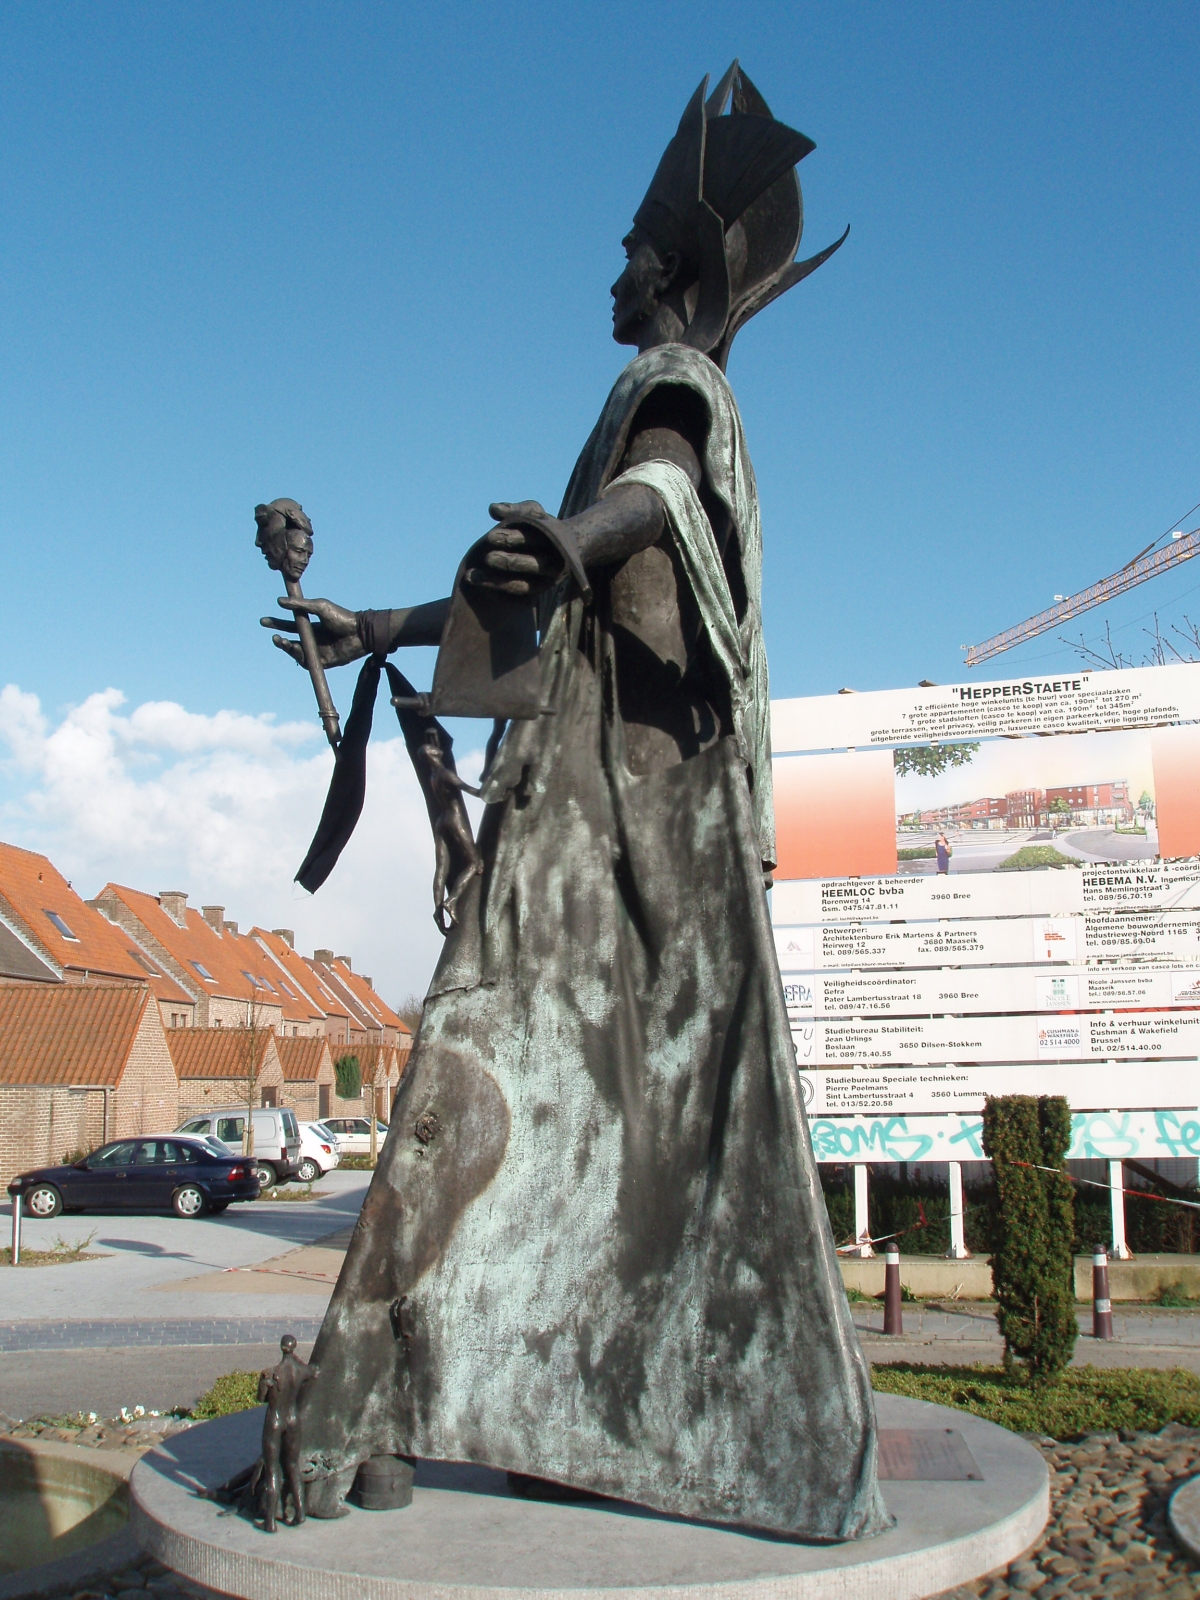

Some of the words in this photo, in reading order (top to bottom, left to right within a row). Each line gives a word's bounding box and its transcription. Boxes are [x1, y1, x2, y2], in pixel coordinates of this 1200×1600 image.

[982, 697, 1023, 705] winkelunits
[1078, 689, 1131, 698] speciaalzaken
[930, 708, 985, 717] appartementen
[987, 705, 1011, 713] (casco
[892, 726, 928, 734] terrassen,
[978, 719, 997, 727] veilig
[999, 718, 1032, 726] parkeren
[1066, 711, 1120, 720] parkeerkelder,
[917, 718, 936, 726] grote
[939, 715, 979, 723] stadsloften
[1017, 709, 1036, 717] koop)
[871, 734, 911, 742] uitgebreide
[914, 726, 1006, 738] veiligheidsvoorzieningen,
[1123, 714, 1149, 722] ligging
[1082, 867, 1160, 877] projectontwikkelaar
[1083, 877, 1132, 886] HEBEMA
[1136, 875, 1157, 883] N.V.
[822, 888, 875, 898] HEEMLOC
[879, 887, 904, 895] bvba
[1105, 885, 1162, 893] Memlingstraat
[823, 934, 883, 942] Architektenburo
[1086, 930, 1164, 939] Industrieweg-Noord
[784, 985, 813, 1001] EFRA
[882, 1075, 917, 1083] Speciale
